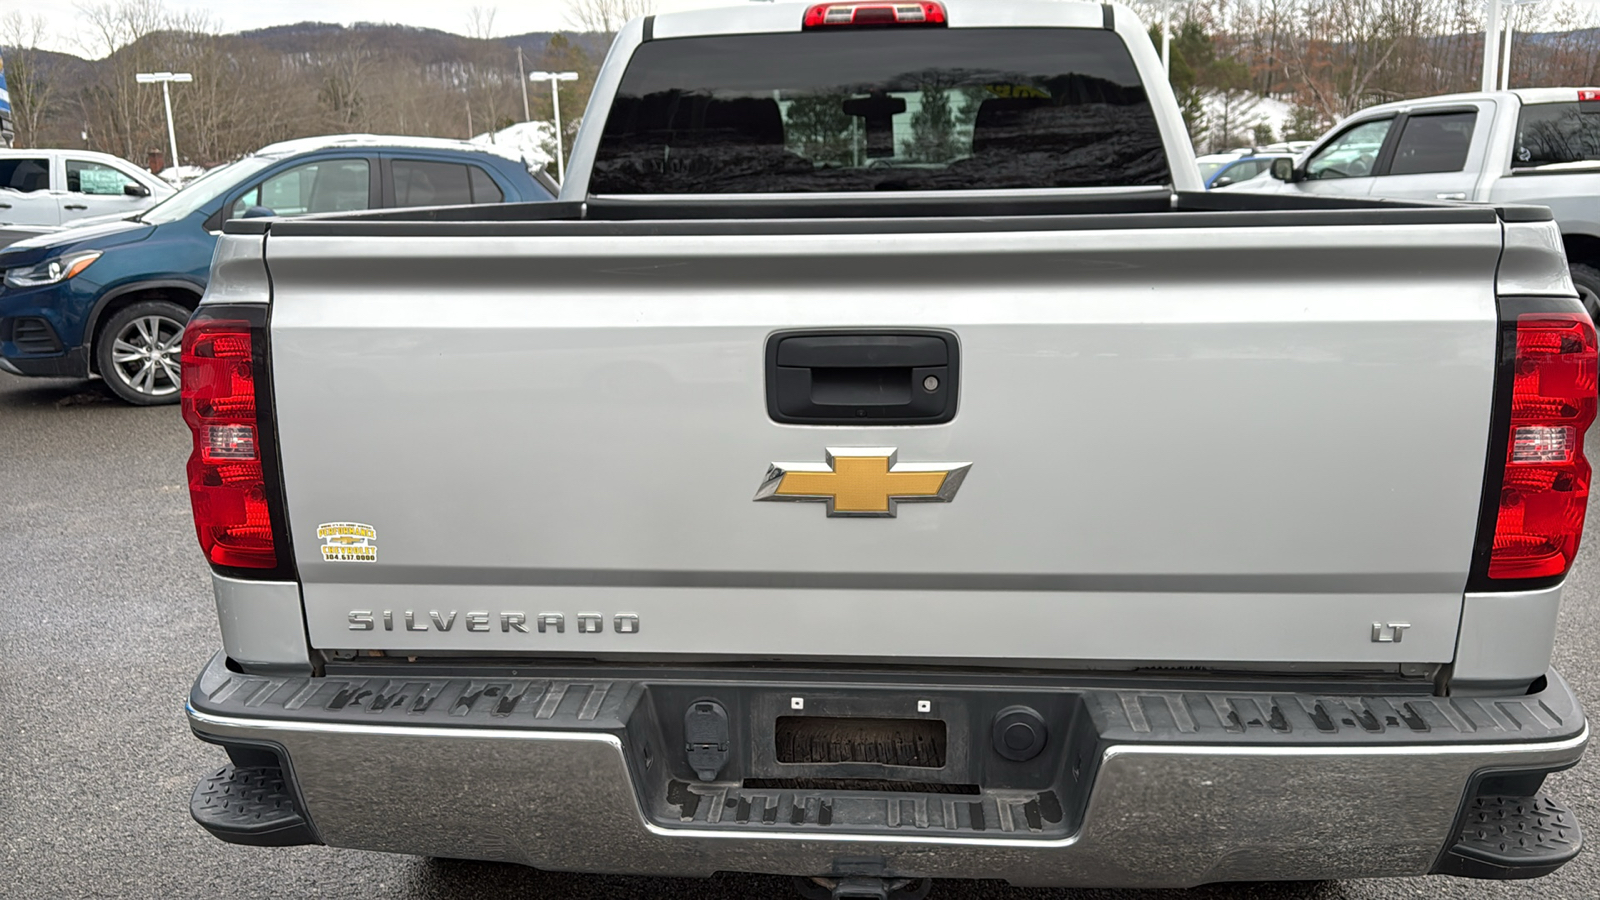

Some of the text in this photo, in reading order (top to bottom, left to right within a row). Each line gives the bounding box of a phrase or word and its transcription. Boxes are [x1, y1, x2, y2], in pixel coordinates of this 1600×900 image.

[319, 527, 374, 538] PERFORMANCE
[322, 545, 376, 555] CHEVROLET
[348, 609, 640, 634] SILVERADO
[1370, 621, 1411, 643] LT
